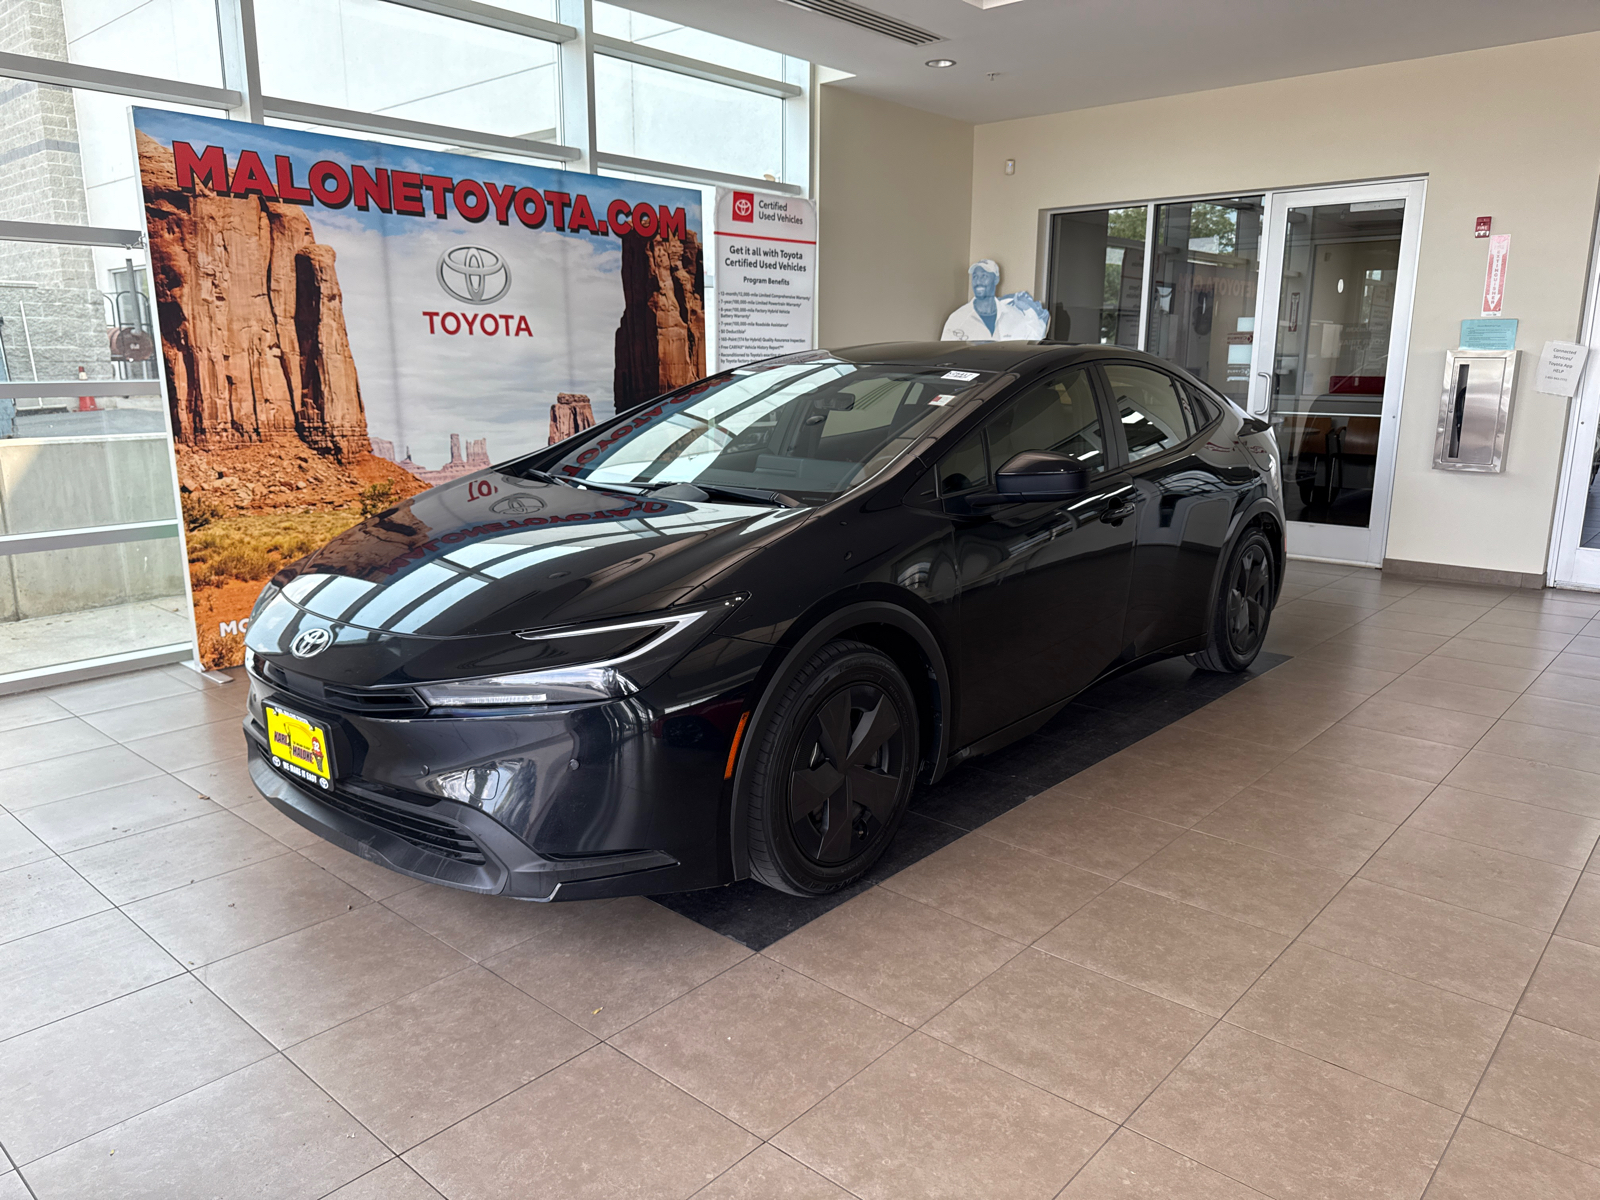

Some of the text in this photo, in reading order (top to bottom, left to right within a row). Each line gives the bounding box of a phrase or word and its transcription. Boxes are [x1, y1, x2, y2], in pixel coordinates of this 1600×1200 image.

[172, 140, 686, 241] MALONETOYOTA.COM
[759, 200, 787, 212] Certified
[759, 211, 803, 225] Used Vehicles
[730, 246, 803, 262] Get it all with Toyota
[725, 258, 806, 272] Certified Used Vehicles
[743, 276, 790, 286] Program Benefits
[422, 311, 534, 337] TOYOTA
[274, 731, 289, 746] KARL
[293, 745, 314, 764] MALONE
